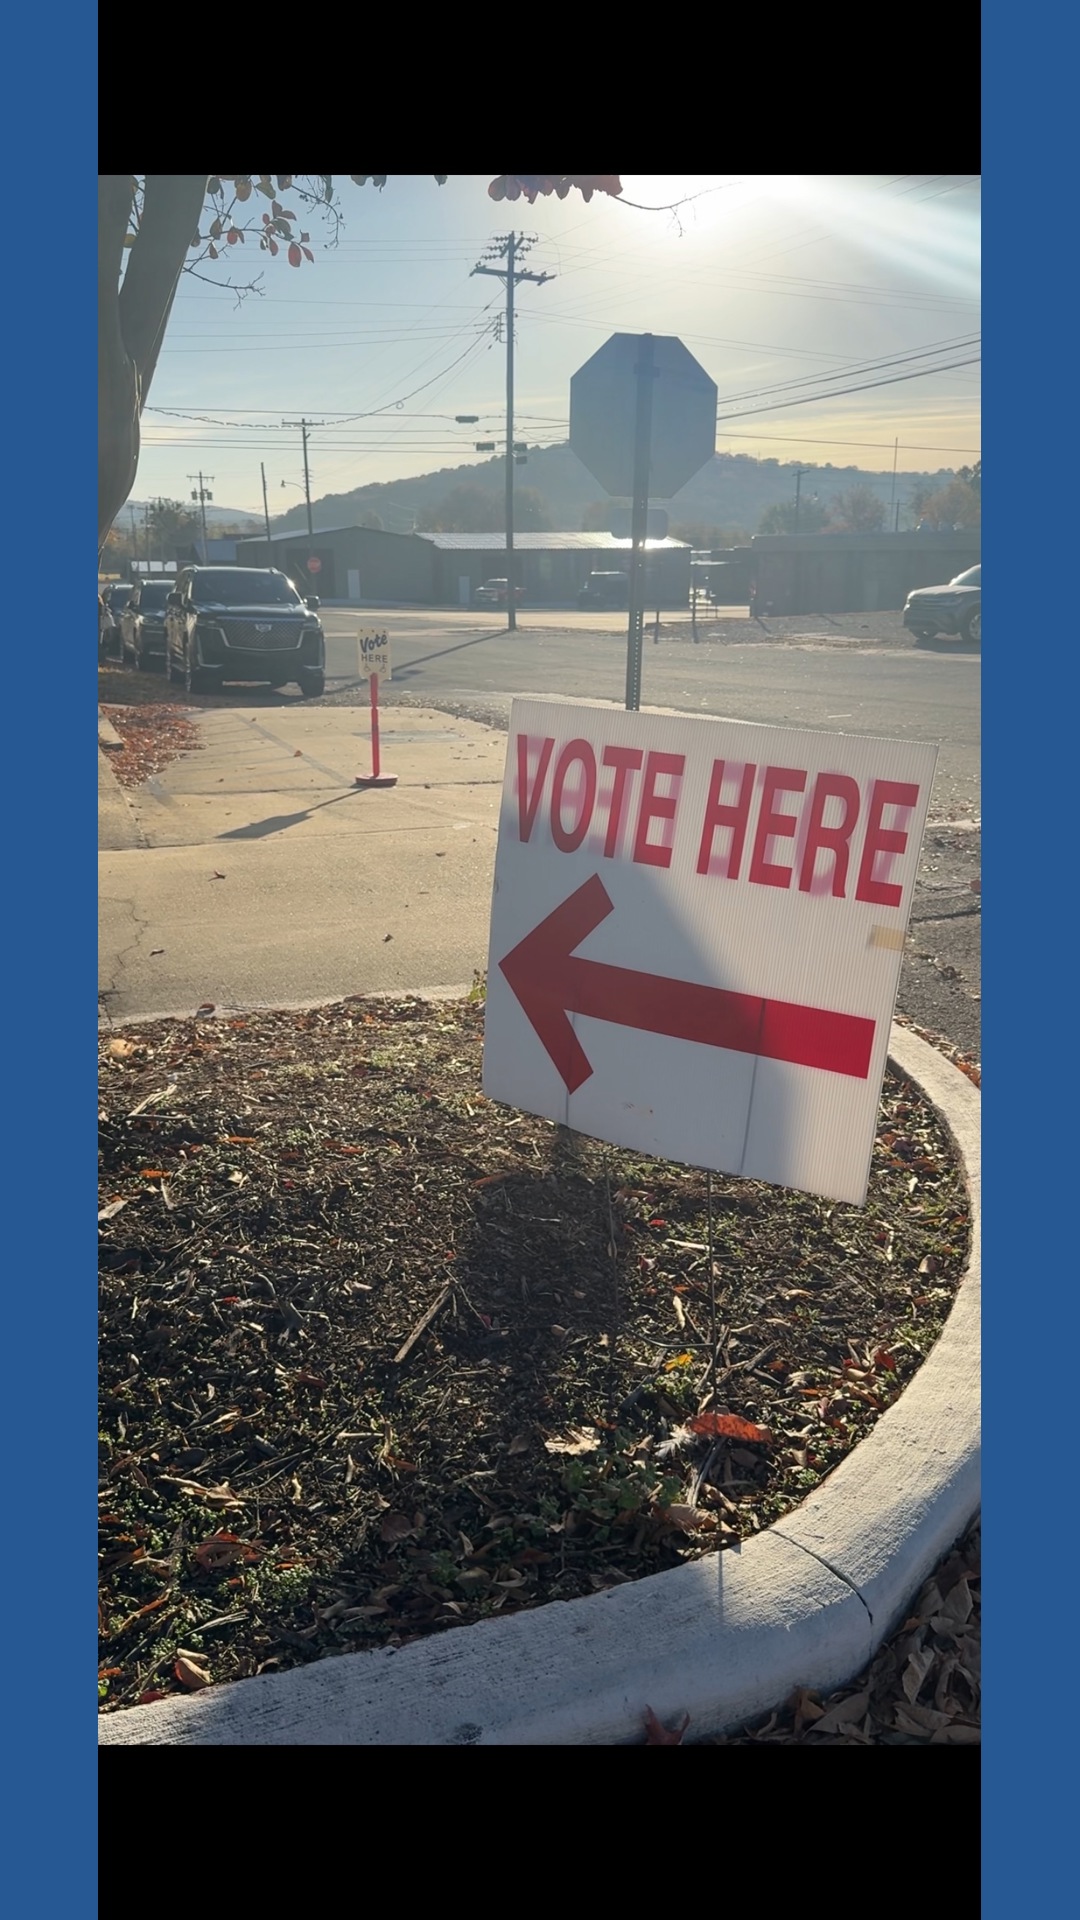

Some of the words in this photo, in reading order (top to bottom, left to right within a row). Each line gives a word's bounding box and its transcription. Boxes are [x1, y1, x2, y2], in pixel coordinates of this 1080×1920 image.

[360, 634, 388, 653] Vote
[361, 654, 388, 663] HERE
[517, 734, 686, 868] VOTE
[696, 759, 920, 907] HERE
